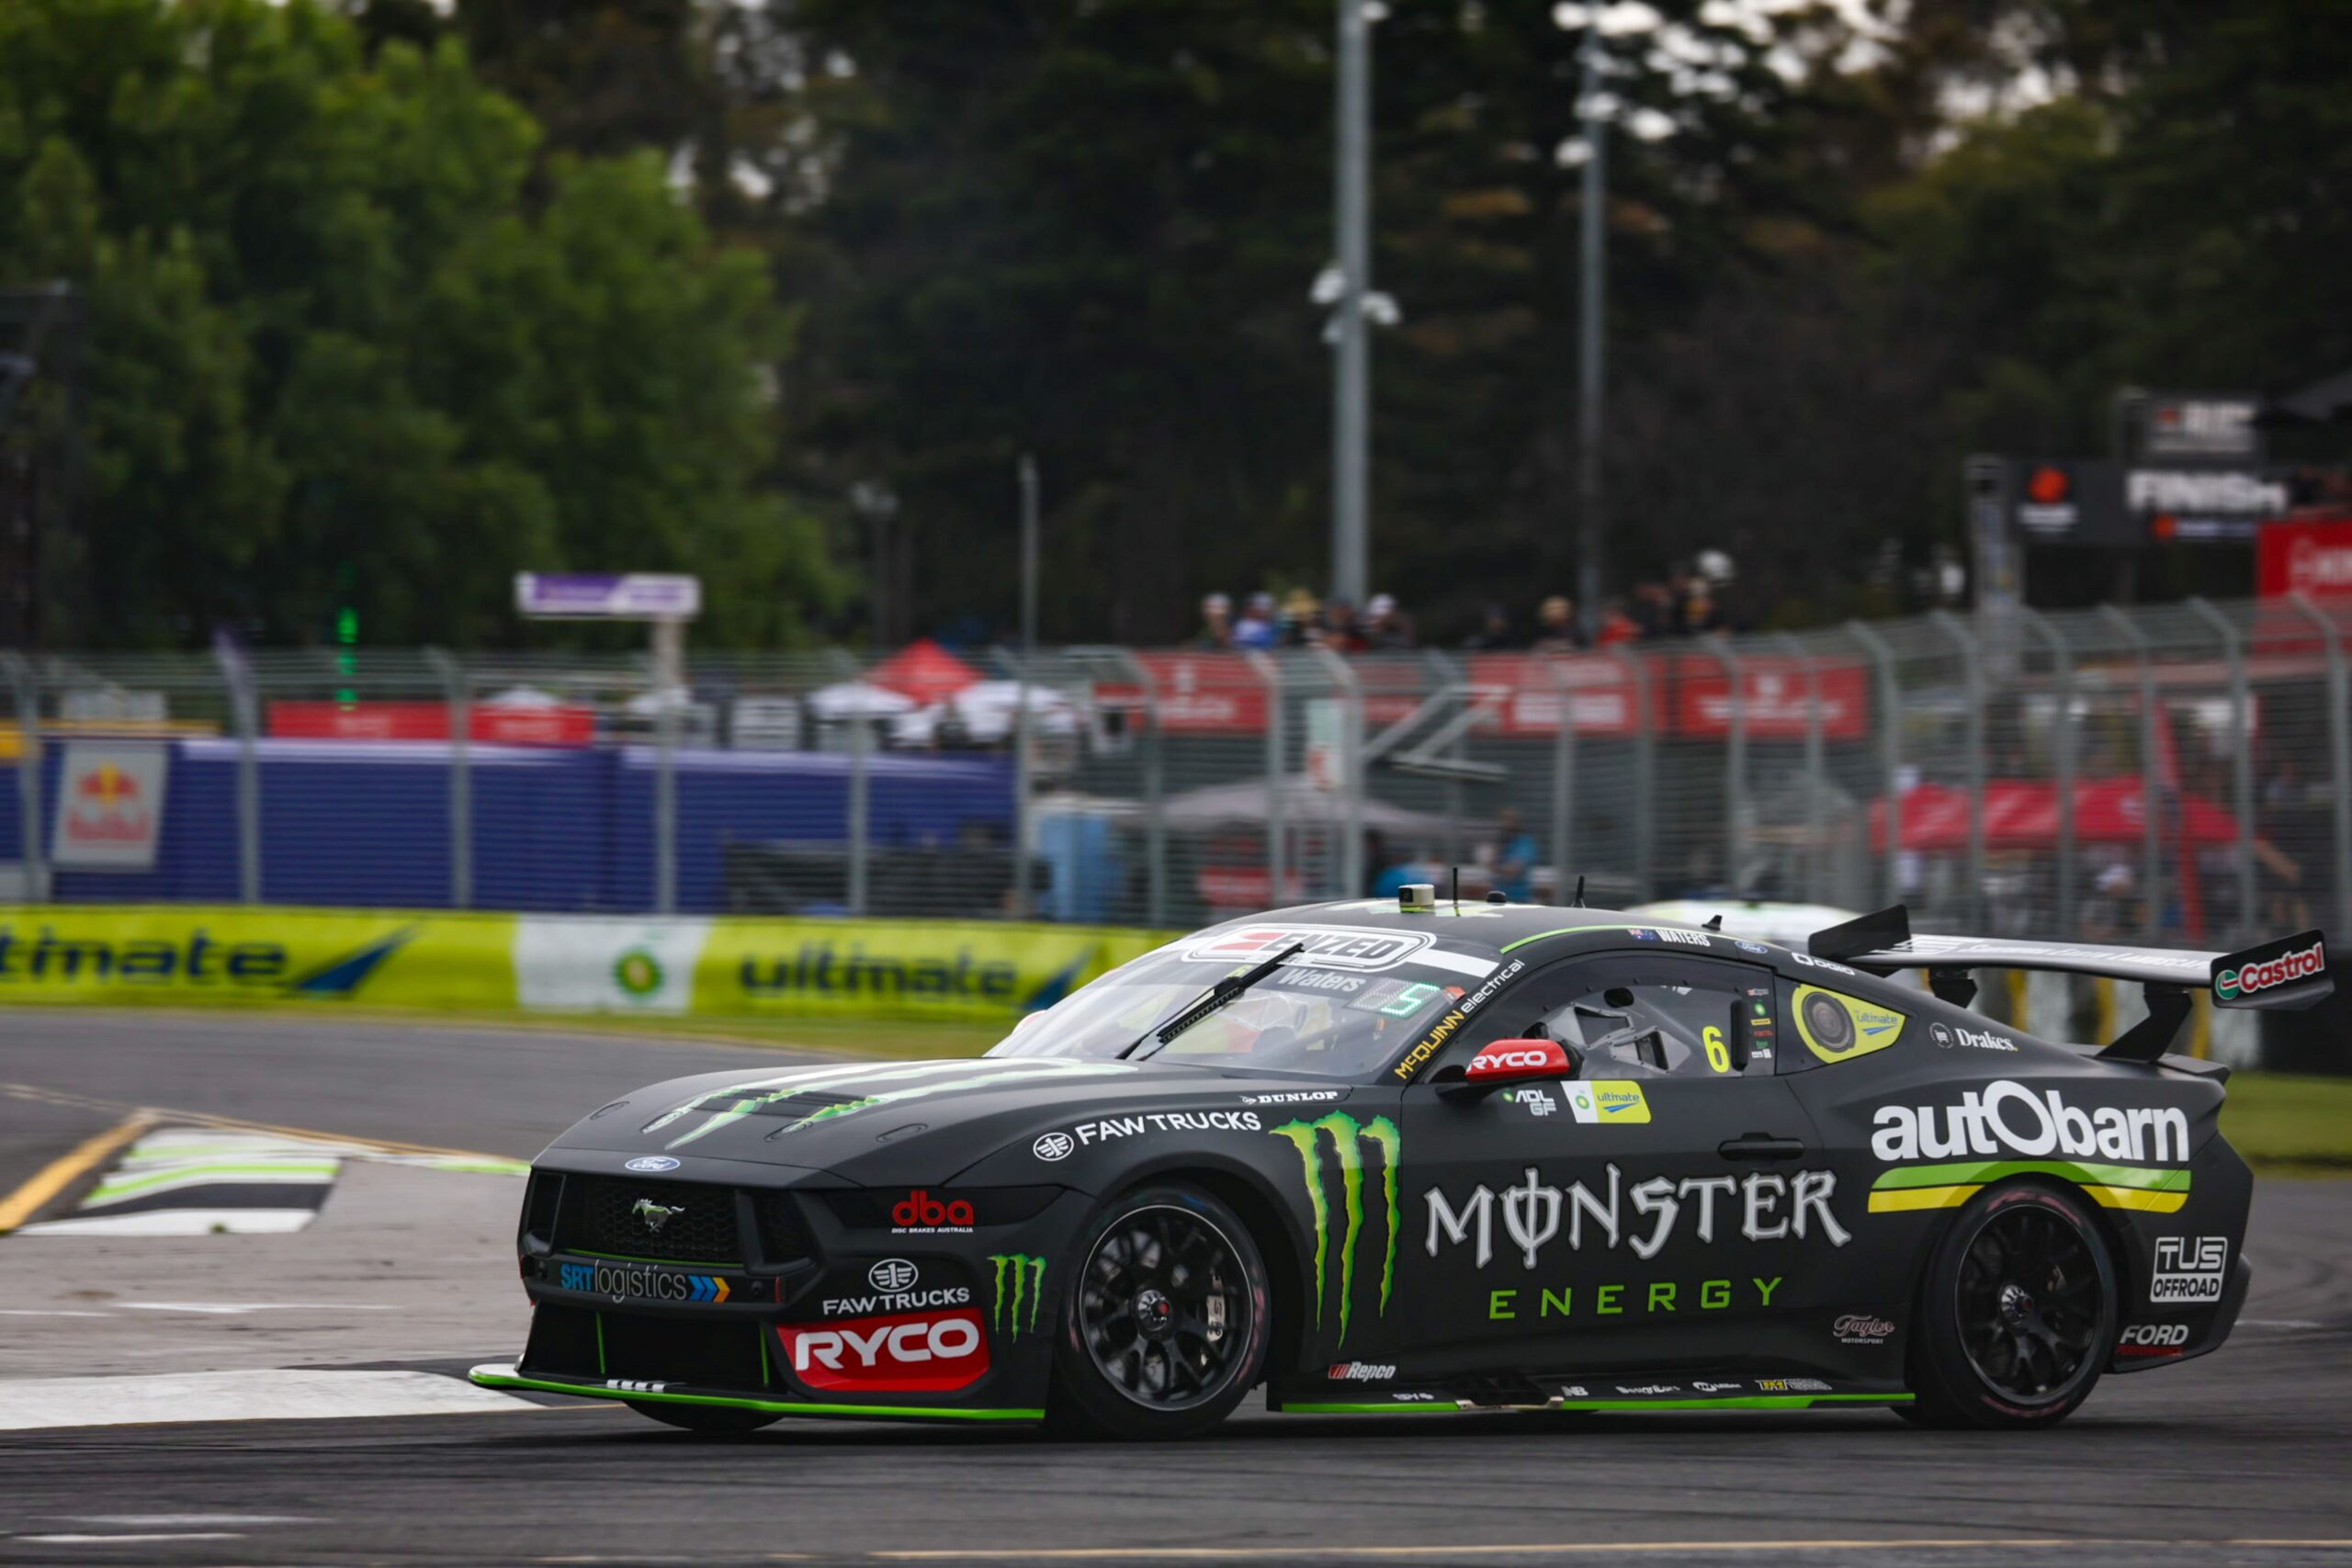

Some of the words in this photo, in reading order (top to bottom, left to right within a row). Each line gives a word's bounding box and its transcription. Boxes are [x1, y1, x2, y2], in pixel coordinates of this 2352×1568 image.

[1657, 929, 1711, 947] WATERS
[740, 942, 1016, 999] ultimate
[2239, 941, 2324, 993] Castrol
[1278, 968, 1366, 992] Waters
[1461, 959, 1525, 1013] electrical
[1702, 1025, 1730, 1073] 6
[1467, 1051, 1547, 1072] RYCO
[1257, 1091, 1338, 1103] DUNLOP
[1598, 1092, 1639, 1101] ultimate
[1530, 1102, 1556, 1116] GF
[1147, 1111, 1262, 1133] TRUCKS
[892, 1190, 974, 1226] dba
[1423, 1162, 1852, 1269] MONSTER
[2159, 1236, 2223, 1269] TUS
[877, 1287, 970, 1310] TRUCKS
[1488, 1277, 1782, 1319] ENERGY
[2153, 1278, 2220, 1298] OFFROAD
[1832, 1314, 1895, 1337] Taylor
[2120, 1325, 2189, 1346] FORD
[796, 1318, 979, 1371] RYCO
[1345, 1360, 1396, 1382] Repco
